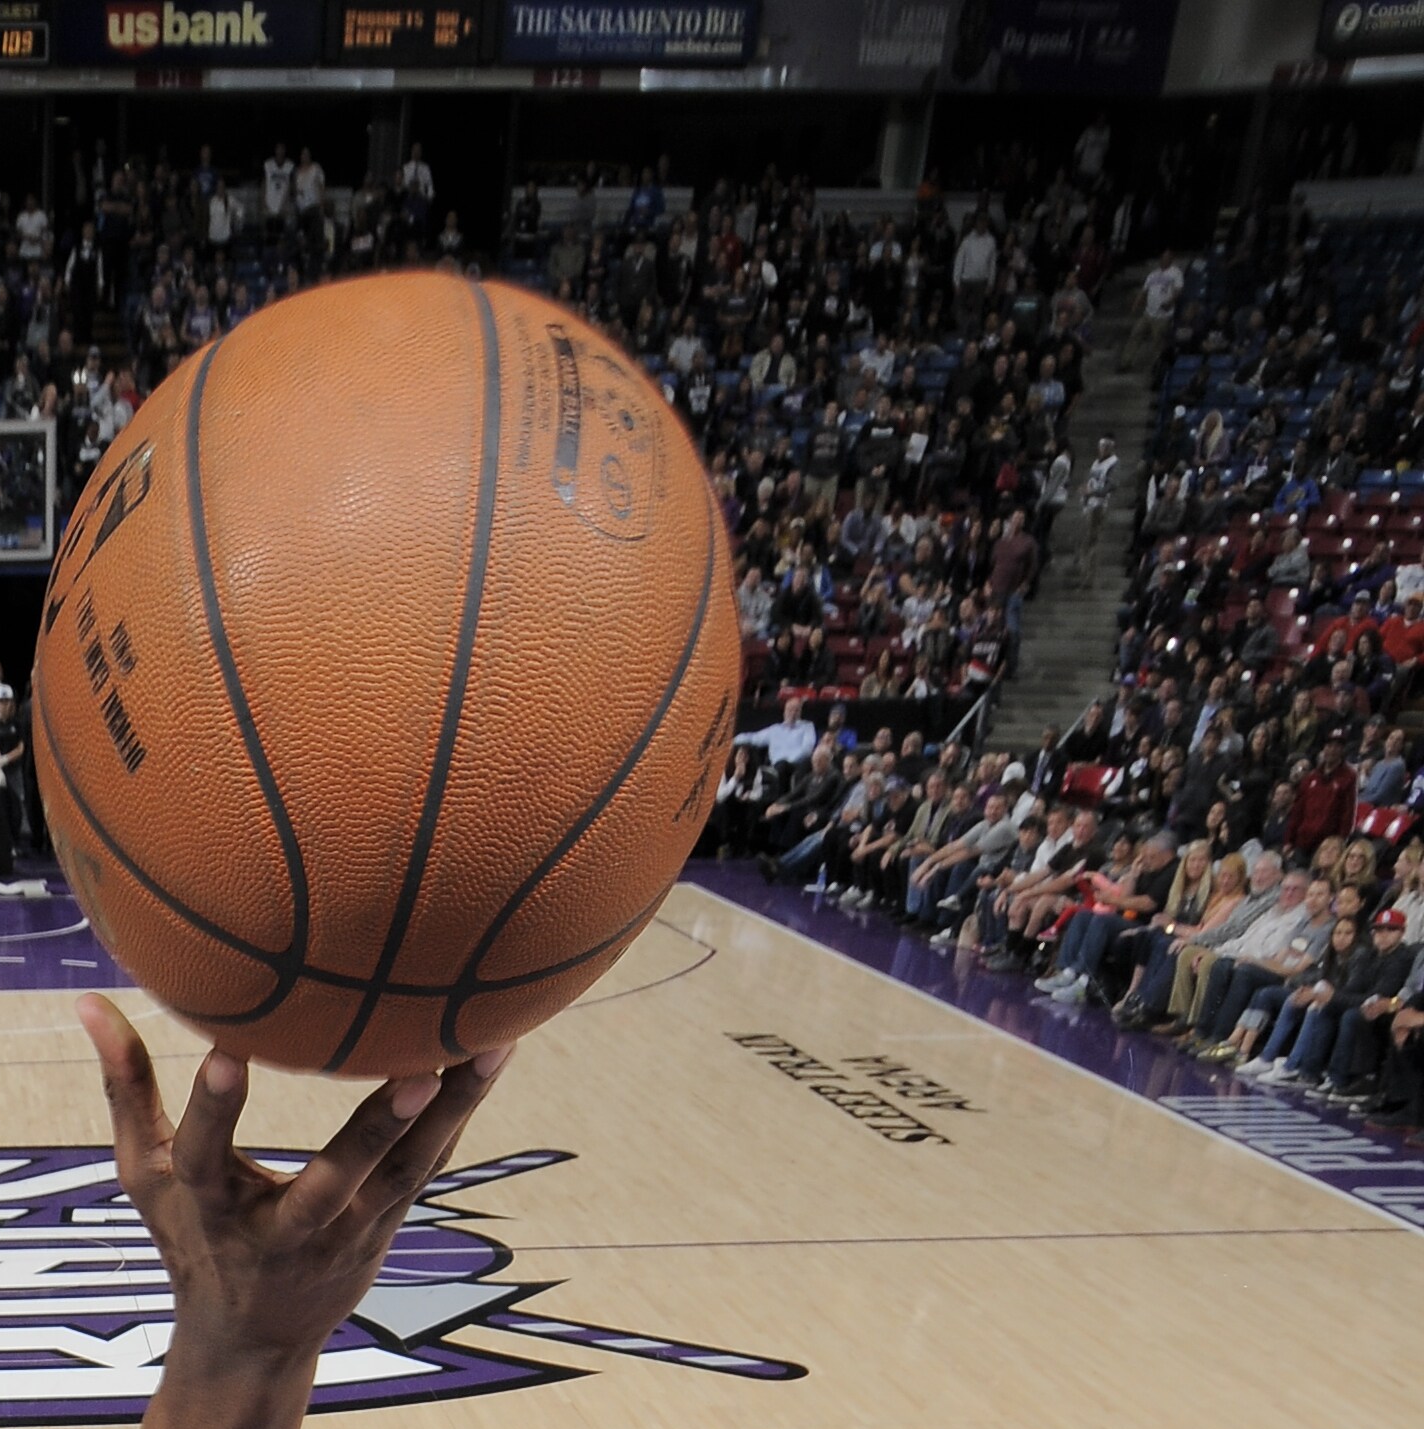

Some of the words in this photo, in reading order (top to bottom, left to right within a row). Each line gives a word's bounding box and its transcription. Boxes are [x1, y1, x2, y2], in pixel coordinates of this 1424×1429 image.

[513, 6, 558, 35] THE
[559, 5, 703, 35] SACRAMENTO
[704, 7, 746, 35] BEE
[723, 1031, 850, 1082] TRAIN
[840, 1055, 988, 1115] ARENA
[810, 1084, 957, 1146] SLEEP
